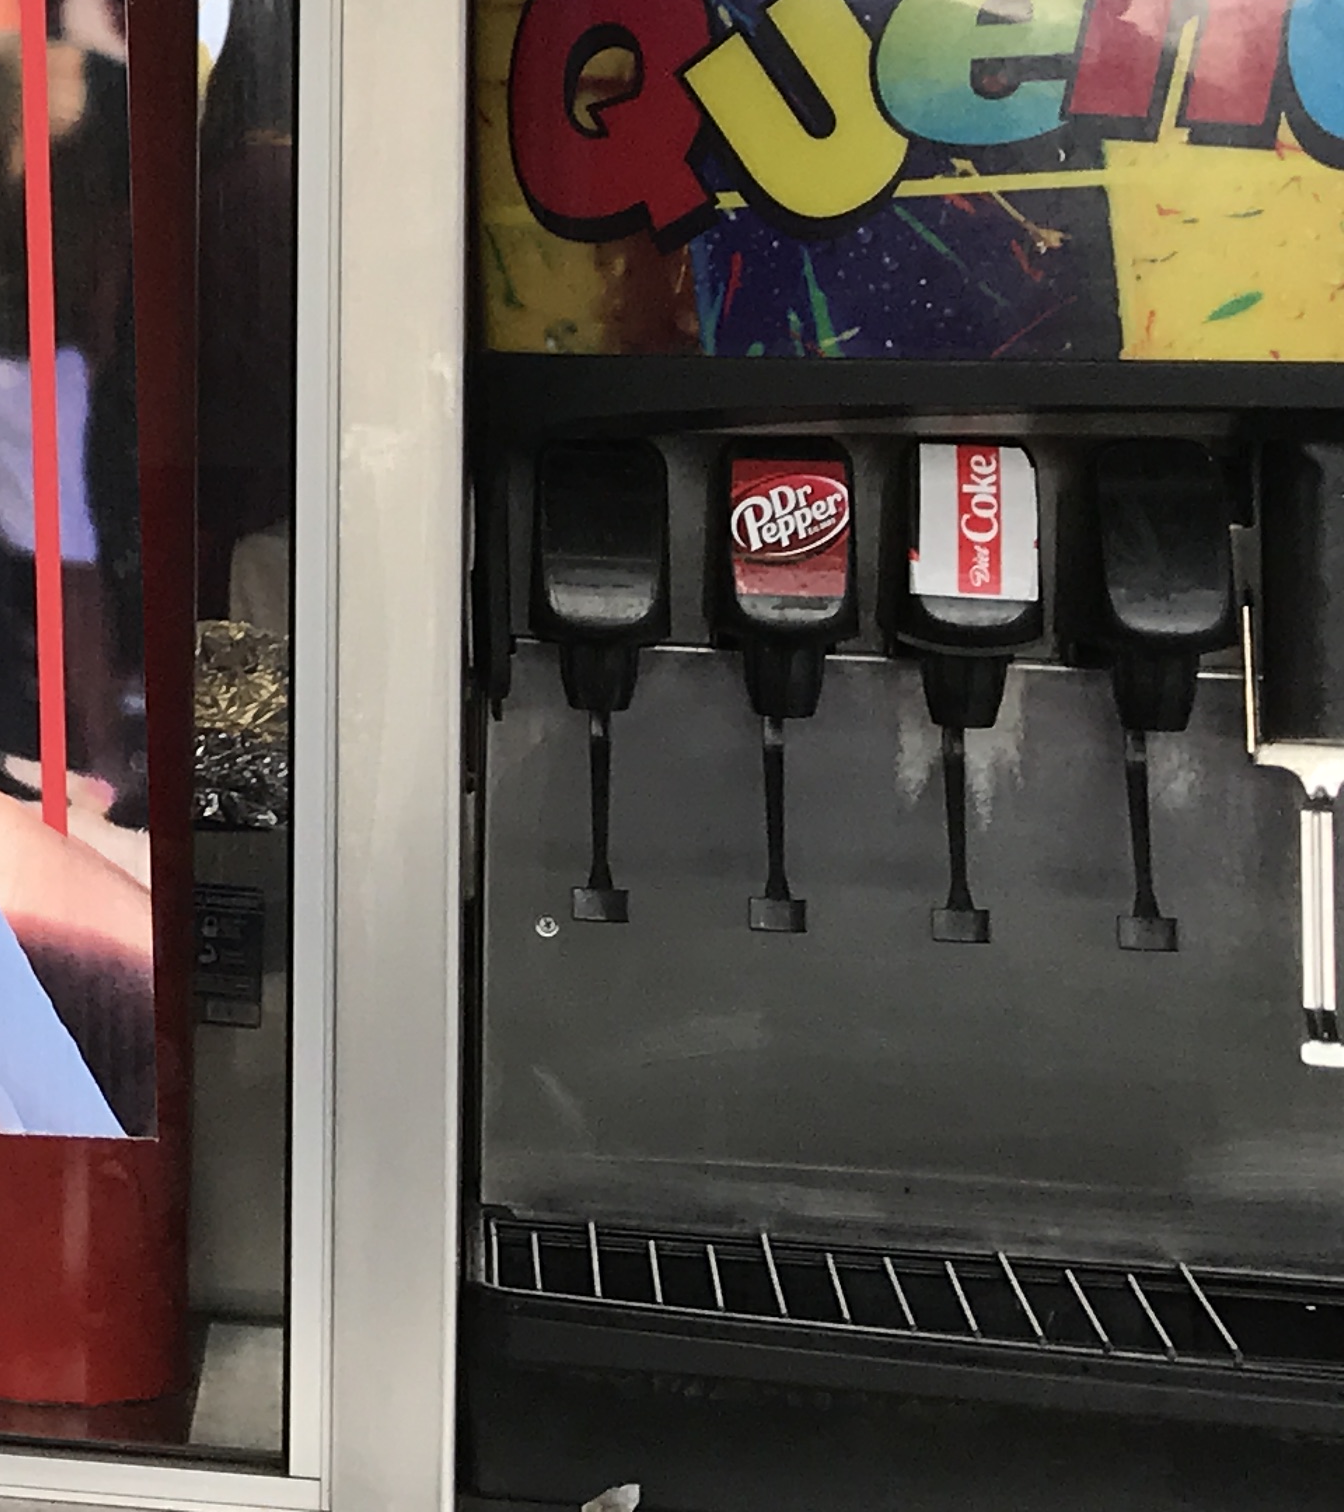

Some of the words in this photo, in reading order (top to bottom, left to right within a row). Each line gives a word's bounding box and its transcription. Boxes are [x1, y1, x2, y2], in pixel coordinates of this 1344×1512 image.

[731, 493, 842, 552] Pepper
[769, 485, 812, 518] Dr
[961, 454, 998, 542] Coke
[969, 545, 990, 587] Diet
